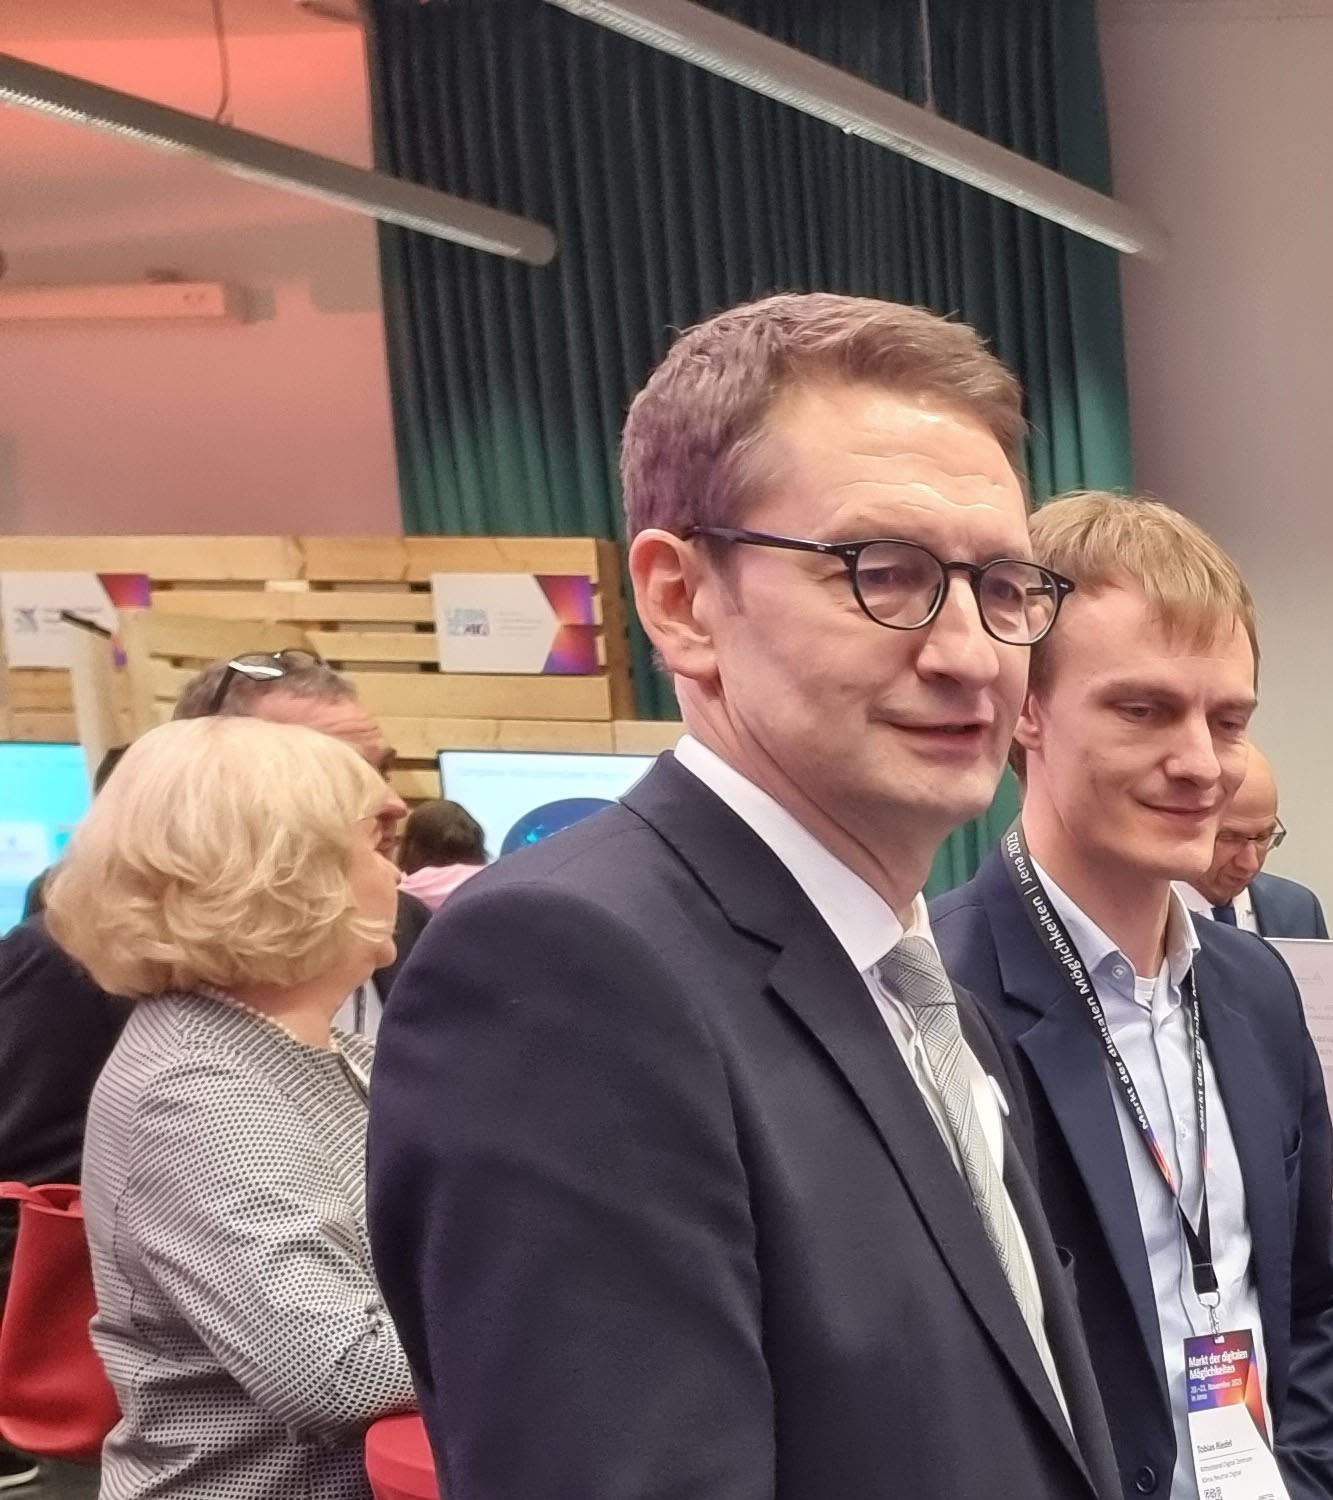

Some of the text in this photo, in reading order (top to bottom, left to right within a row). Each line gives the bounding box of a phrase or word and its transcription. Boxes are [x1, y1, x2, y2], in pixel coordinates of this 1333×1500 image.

[1014, 857, 1033, 885] Jena
[1032, 896, 1090, 995] Möglichkeiten
[1086, 996, 1117, 1058] digitalen
[1116, 1061, 1130, 1084] der
[1127, 1086, 1149, 1130] Markt
